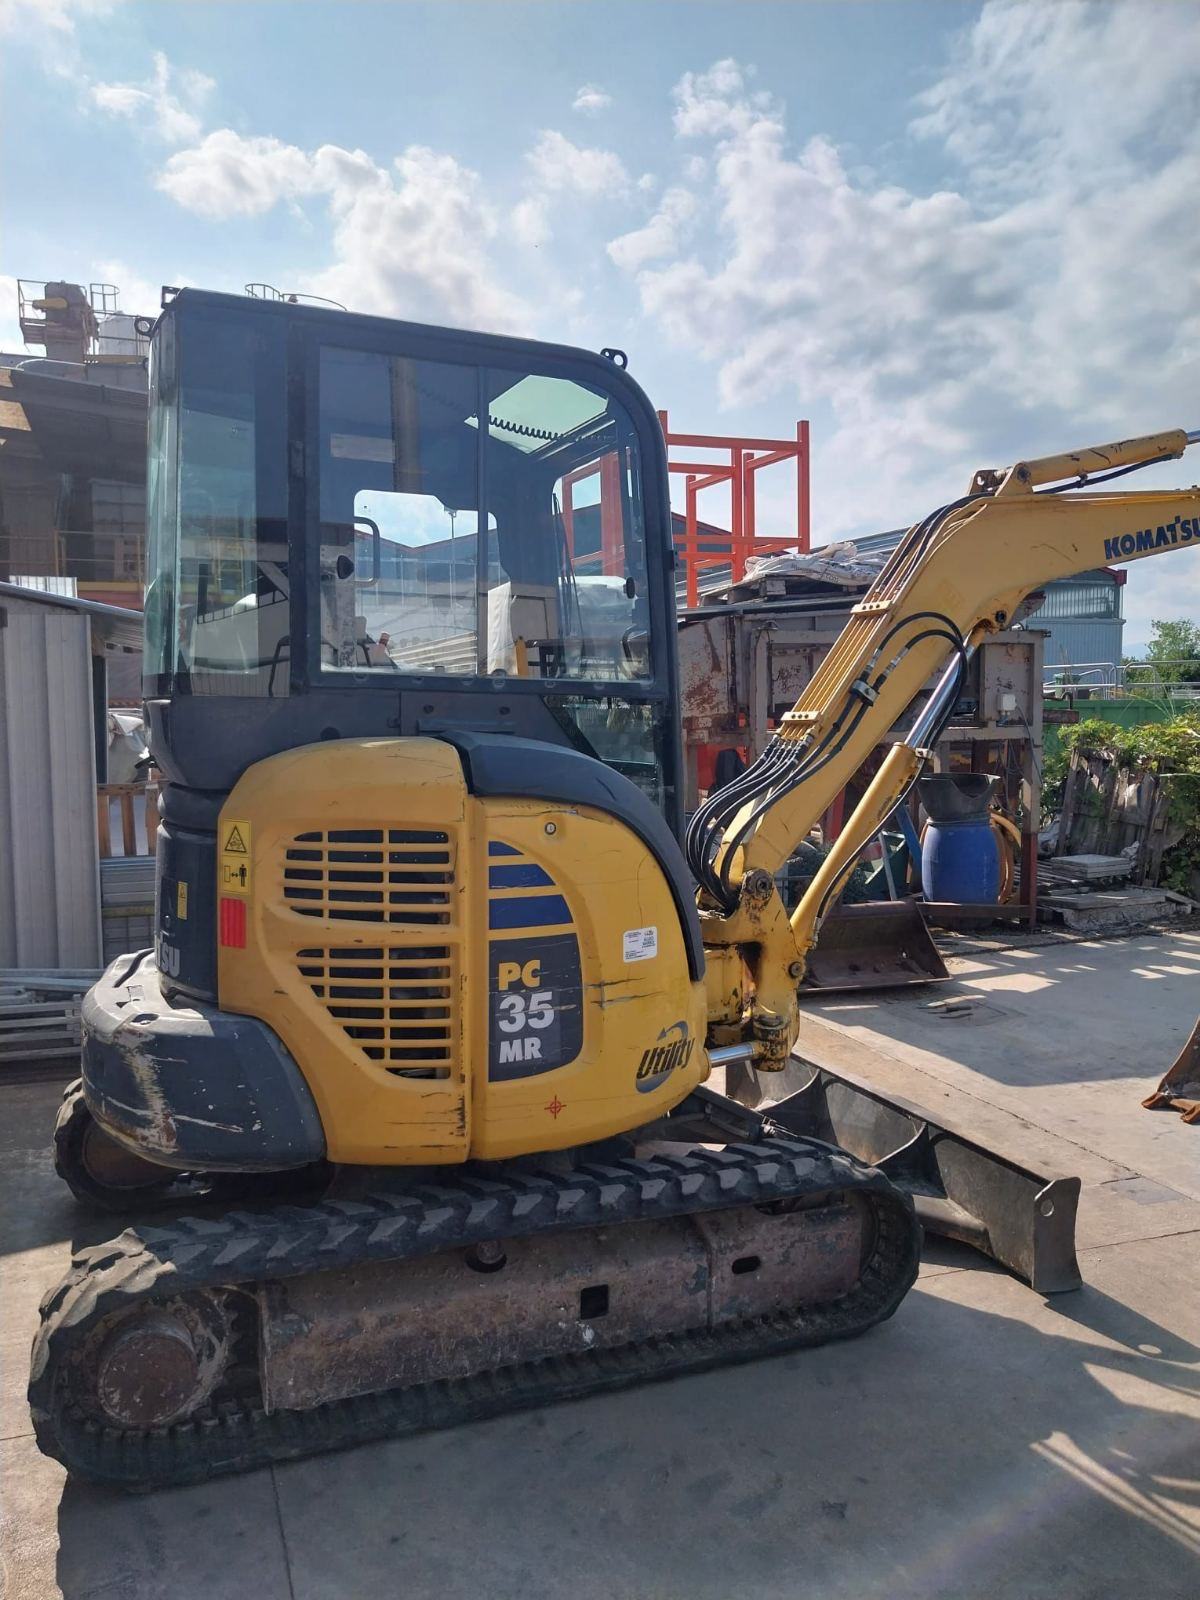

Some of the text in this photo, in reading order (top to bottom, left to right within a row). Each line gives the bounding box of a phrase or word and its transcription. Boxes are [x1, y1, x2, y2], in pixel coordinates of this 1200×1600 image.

[499, 960, 540, 990] PC
[499, 991, 554, 1032] 35
[499, 1037, 542, 1063] MR
[637, 1038, 695, 1079] Utility
